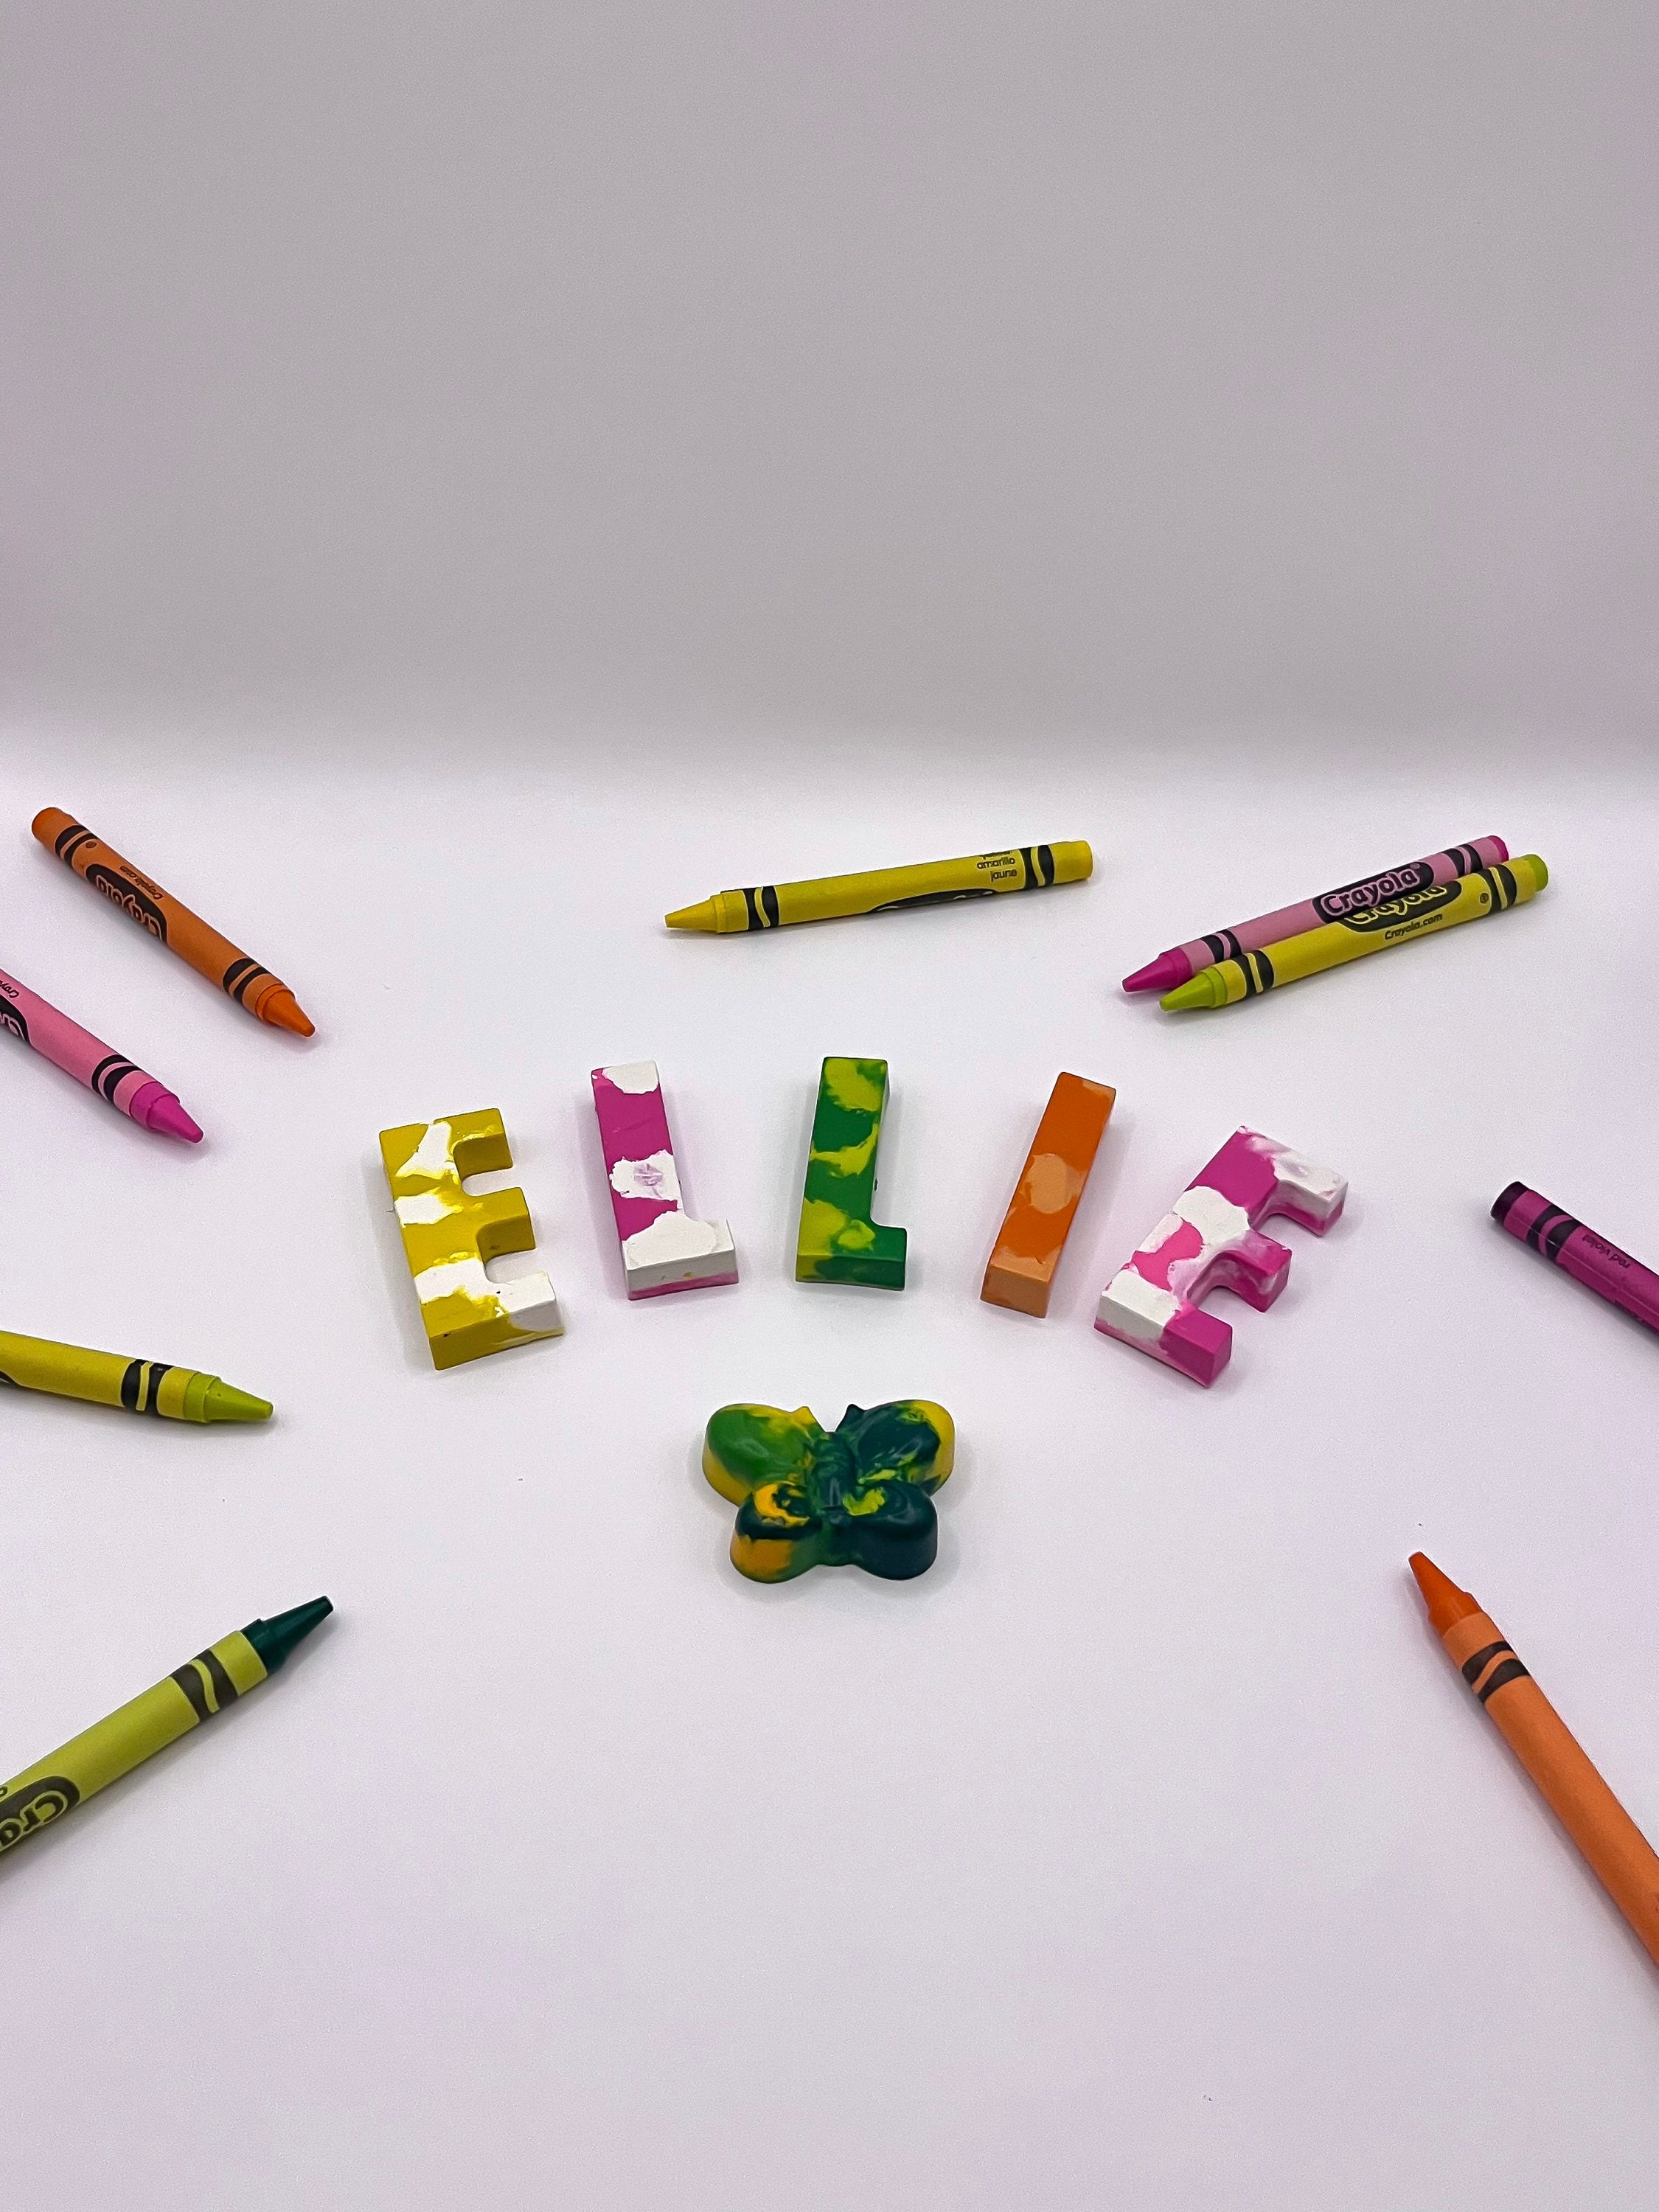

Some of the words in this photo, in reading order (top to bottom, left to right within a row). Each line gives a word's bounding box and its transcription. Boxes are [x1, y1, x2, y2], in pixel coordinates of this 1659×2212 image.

[977, 857, 1015, 869] amarillo
[990, 869, 1018, 883] jaune
[1320, 866, 1422, 917] Crayola
[1384, 913, 1443, 941] Crayola.com
[1608, 1253, 1631, 1269] red
